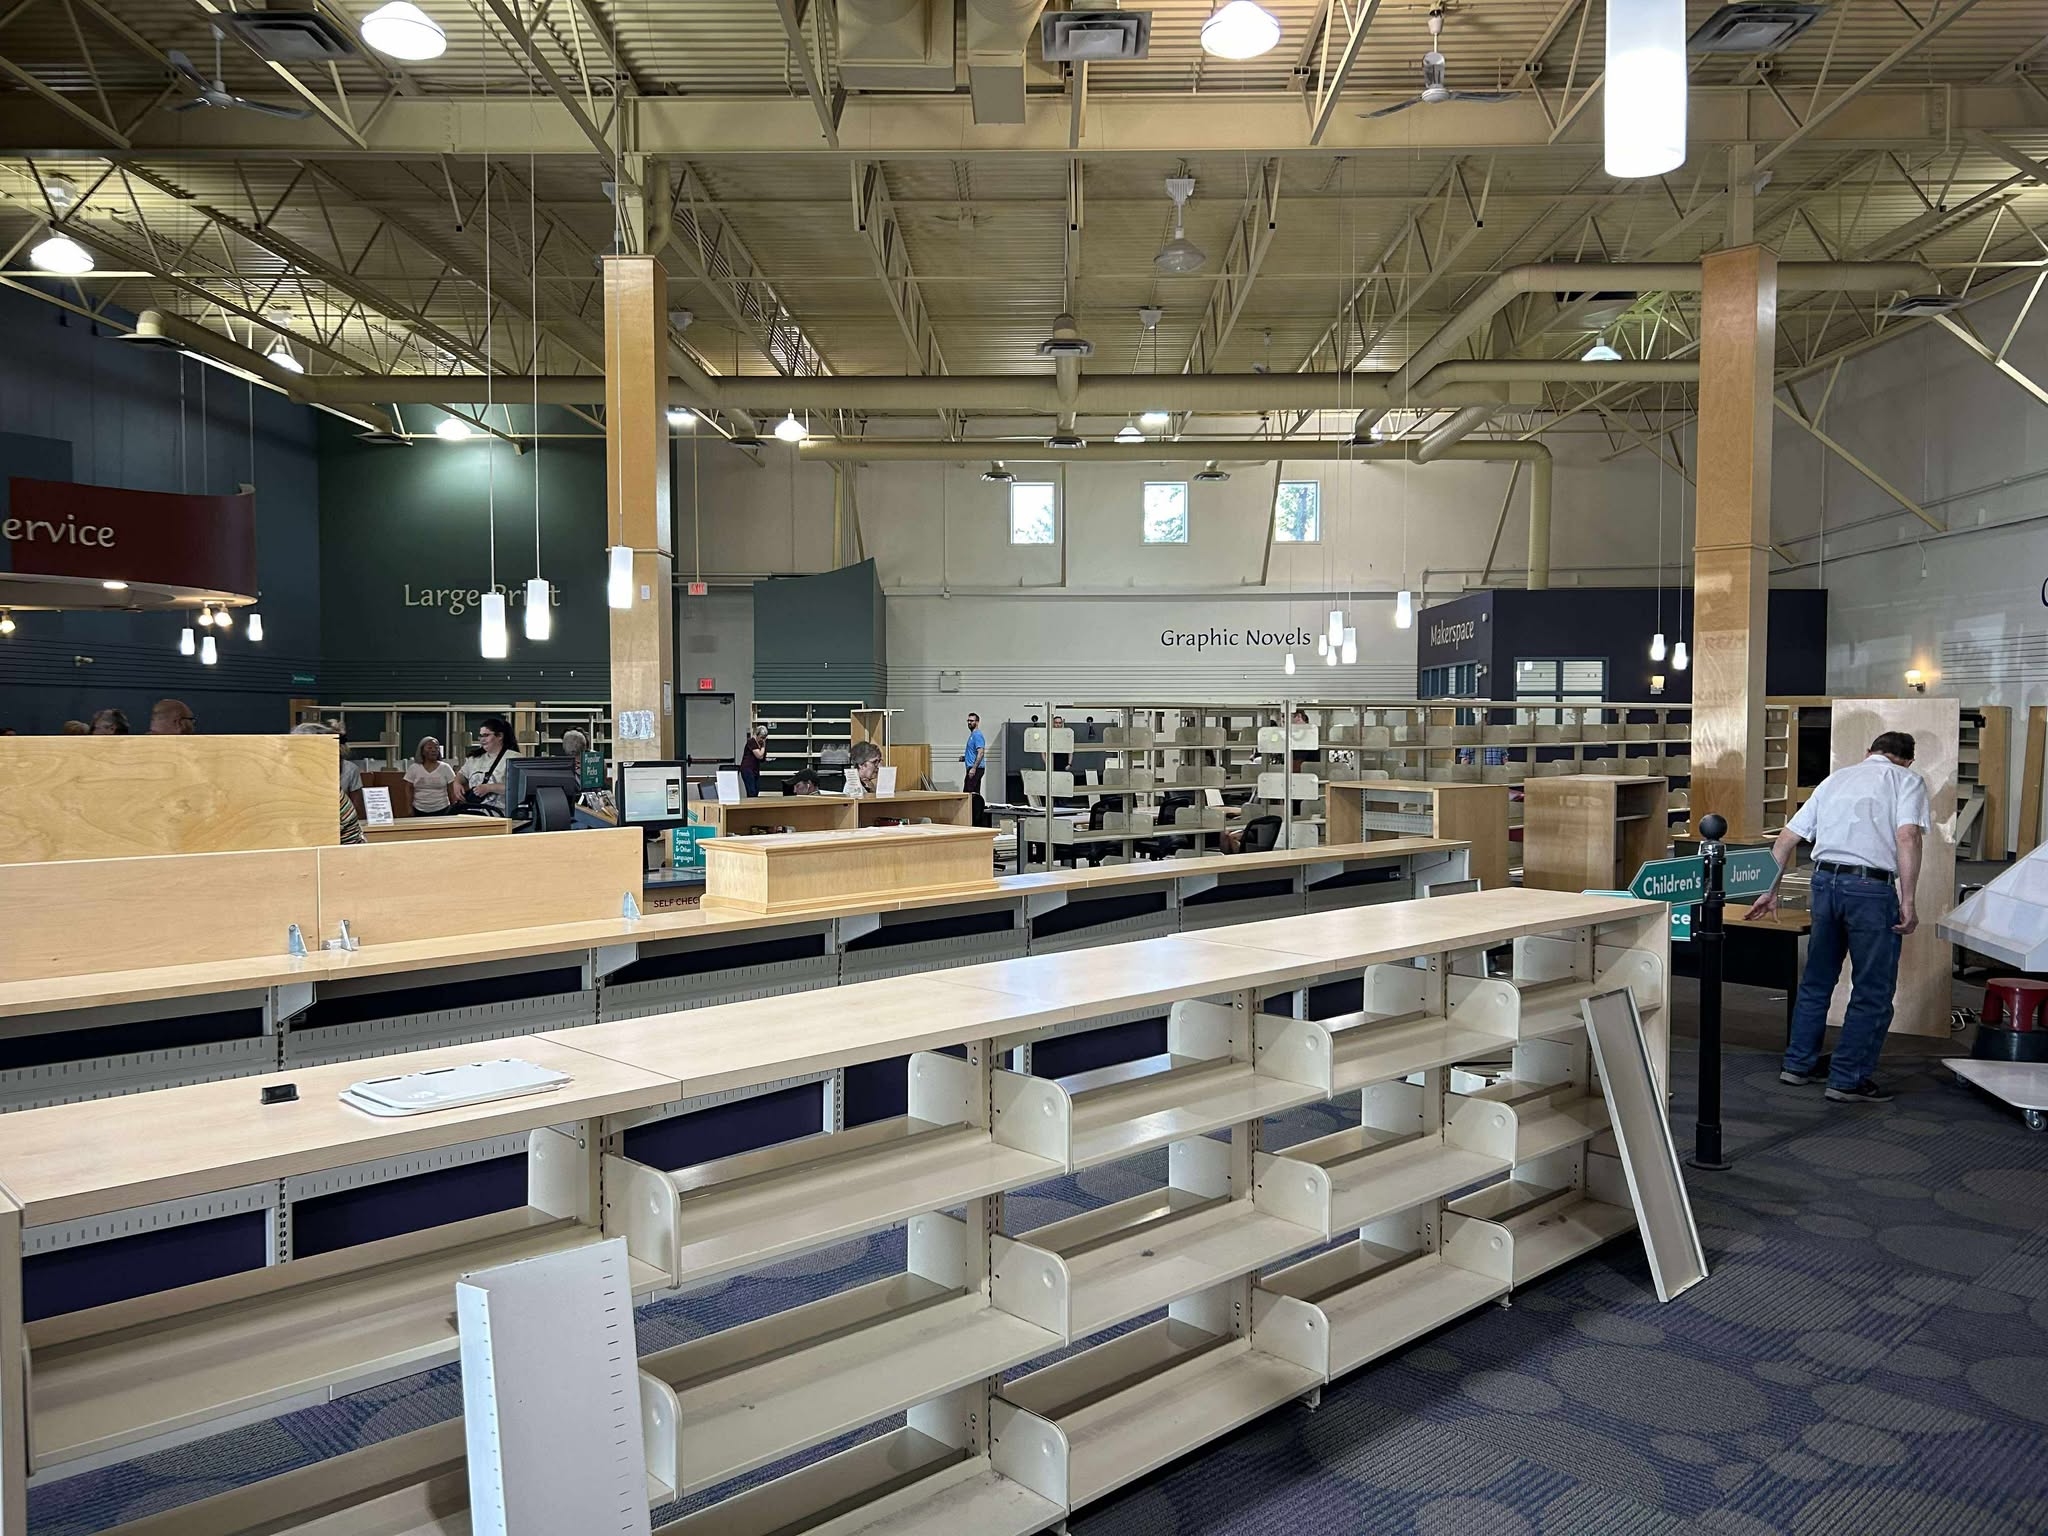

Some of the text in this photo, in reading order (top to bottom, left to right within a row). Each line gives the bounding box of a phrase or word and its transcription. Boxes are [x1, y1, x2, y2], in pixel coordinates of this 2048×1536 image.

[2, 514, 116, 547] ervice
[404, 583, 561, 615] Large rit
[1161, 627, 1311, 652] Graphic Novels
[1430, 619, 1475, 651] Makerspace
[1643, 871, 1701, 896] Children's
[1730, 864, 1761, 883] Junior
[653, 896, 700, 908] SELF CHEC
[1671, 913, 1691, 925] ce
